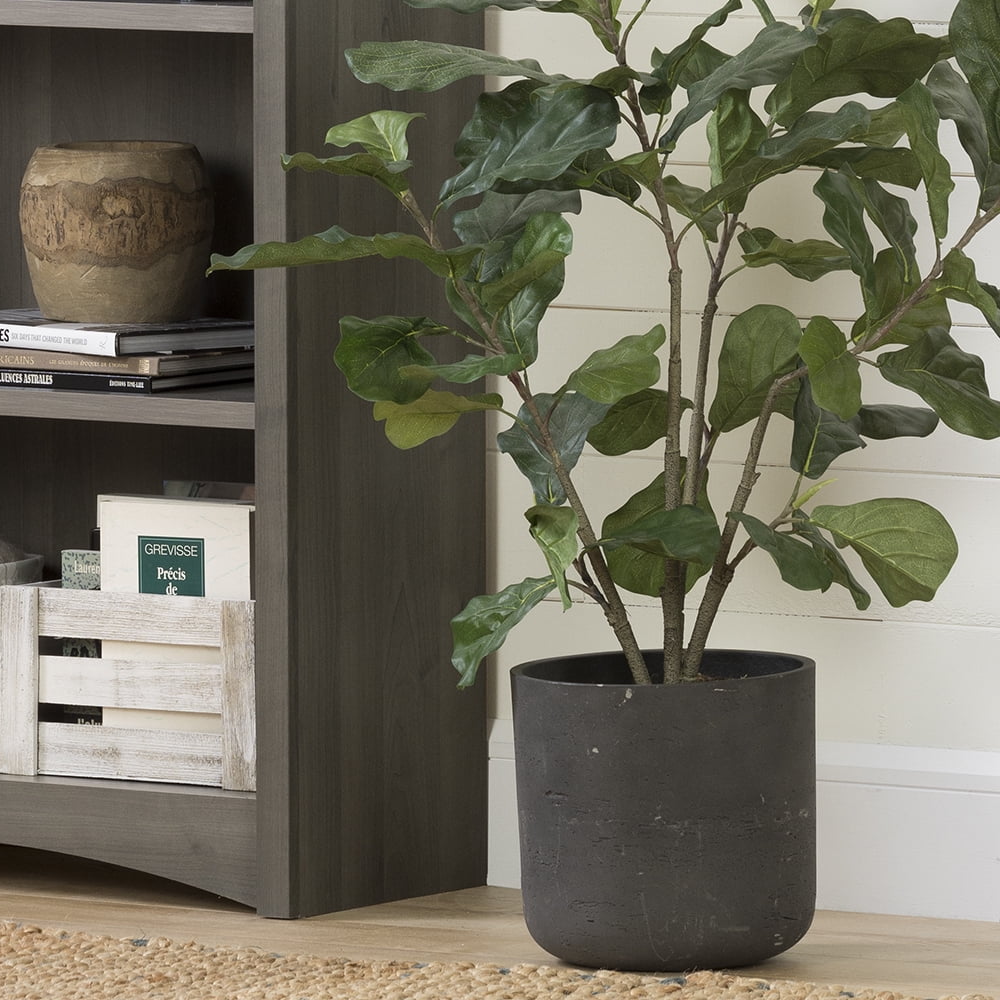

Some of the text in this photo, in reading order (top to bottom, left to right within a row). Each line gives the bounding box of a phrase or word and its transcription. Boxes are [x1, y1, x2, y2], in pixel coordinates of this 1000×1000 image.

[41, 335, 62, 344] CHANGED
[23, 373, 53, 385] ASTRALES
[144, 543, 198, 557] GREVISSE
[156, 566, 187, 581] Précis
[165, 582, 178, 596] de
